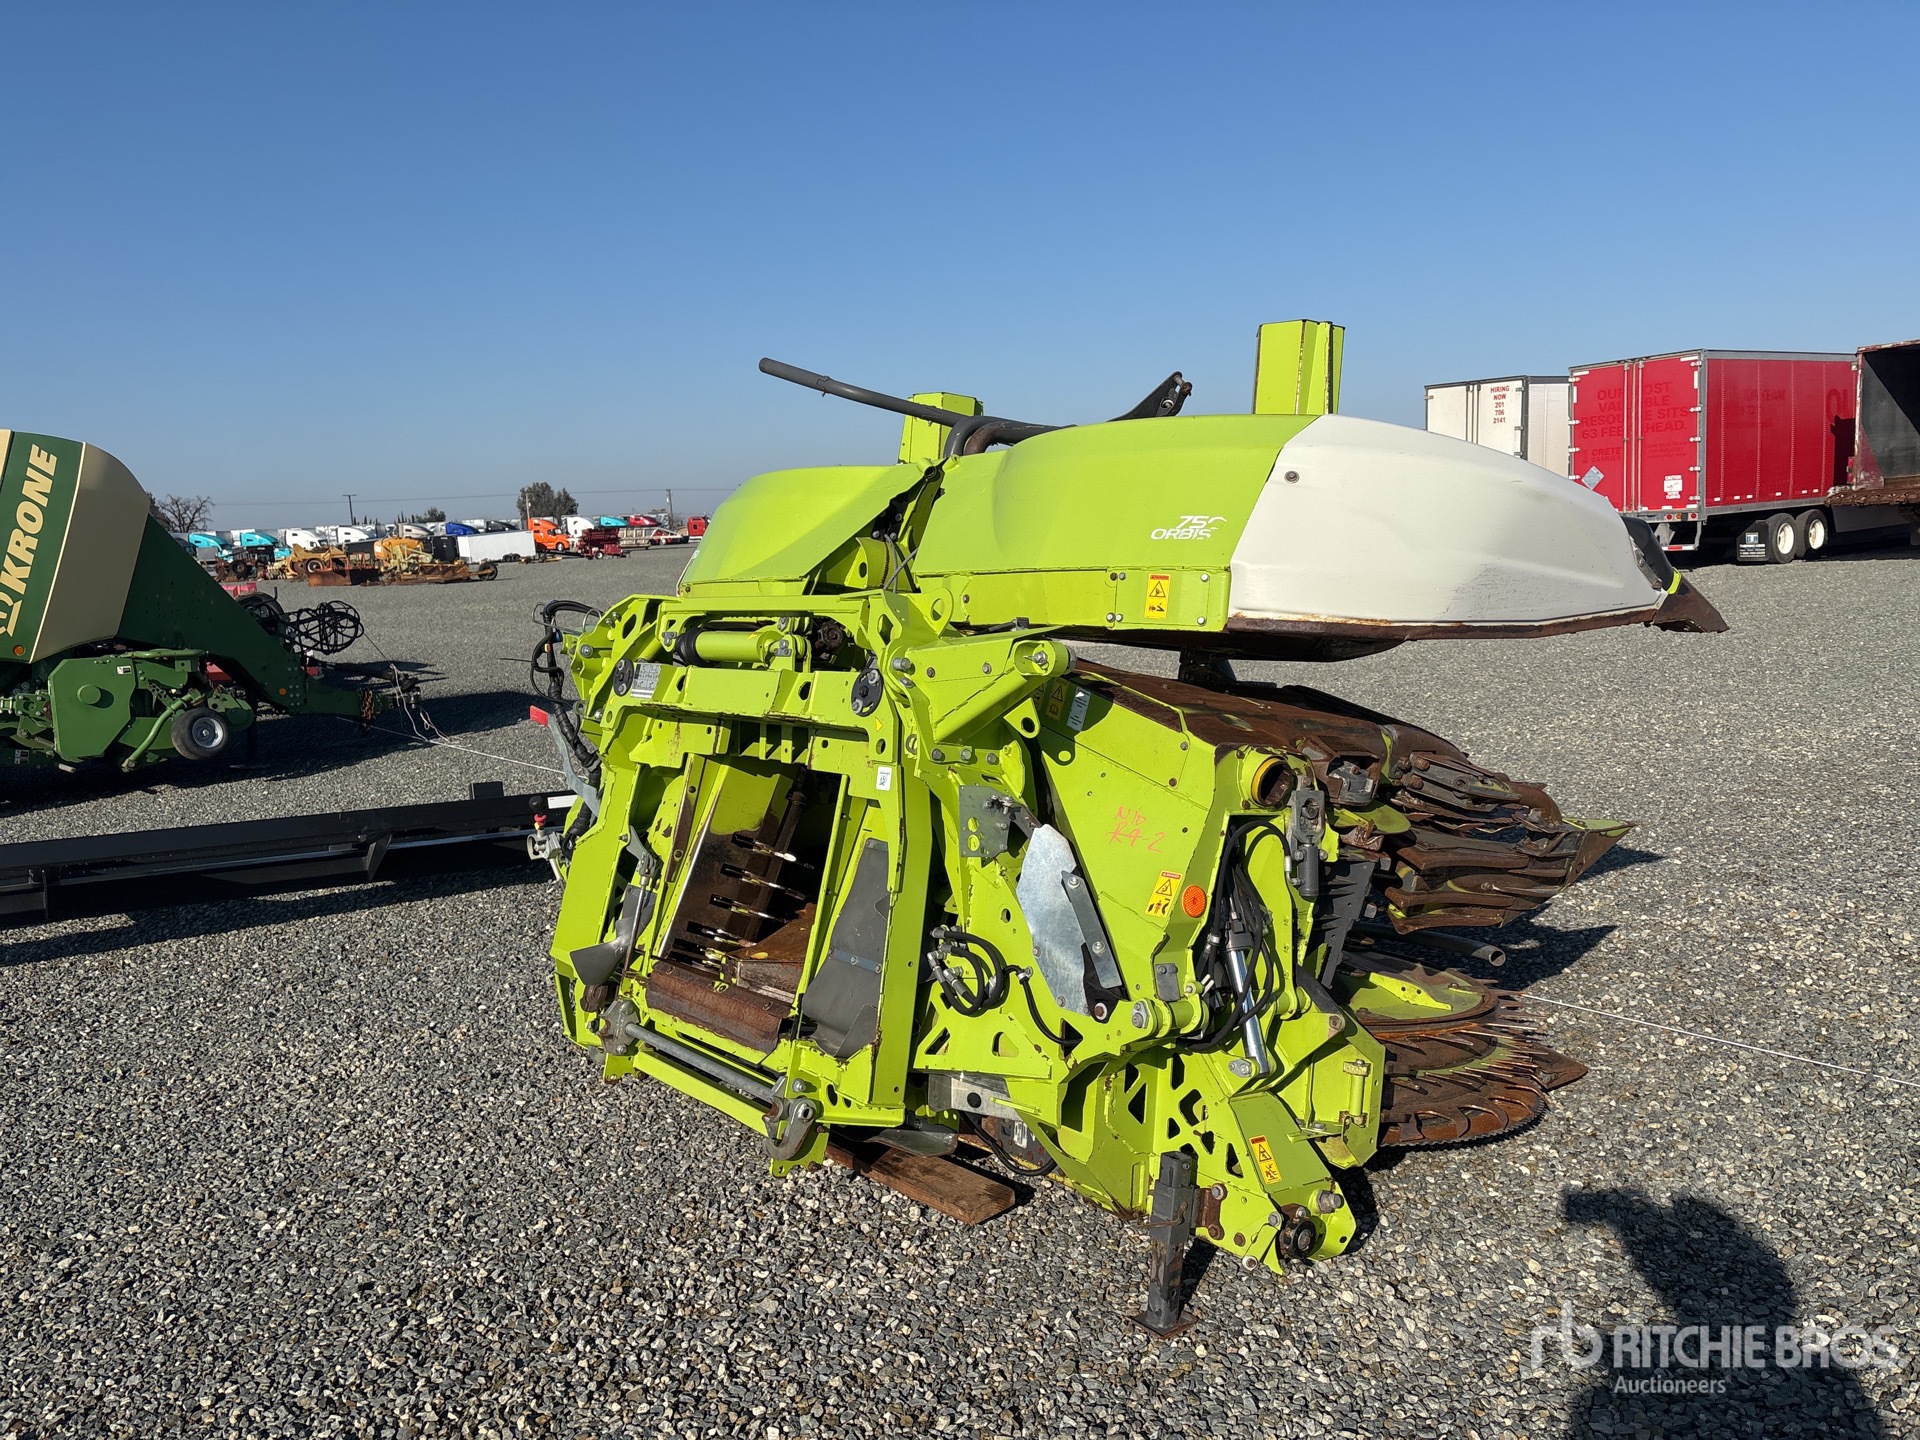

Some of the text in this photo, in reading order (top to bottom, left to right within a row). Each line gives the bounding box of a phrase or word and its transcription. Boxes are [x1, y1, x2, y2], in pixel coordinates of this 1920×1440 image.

[1490, 385, 1509, 393] HIRING
[1494, 401, 1504, 409] 201
[1657, 406, 1689, 419] SITS
[1581, 429, 1598, 440] 63
[1591, 446, 1623, 457] CRETE
[0, 444, 58, 596] KRONE
[1150, 528, 1212, 540] ORBIS
